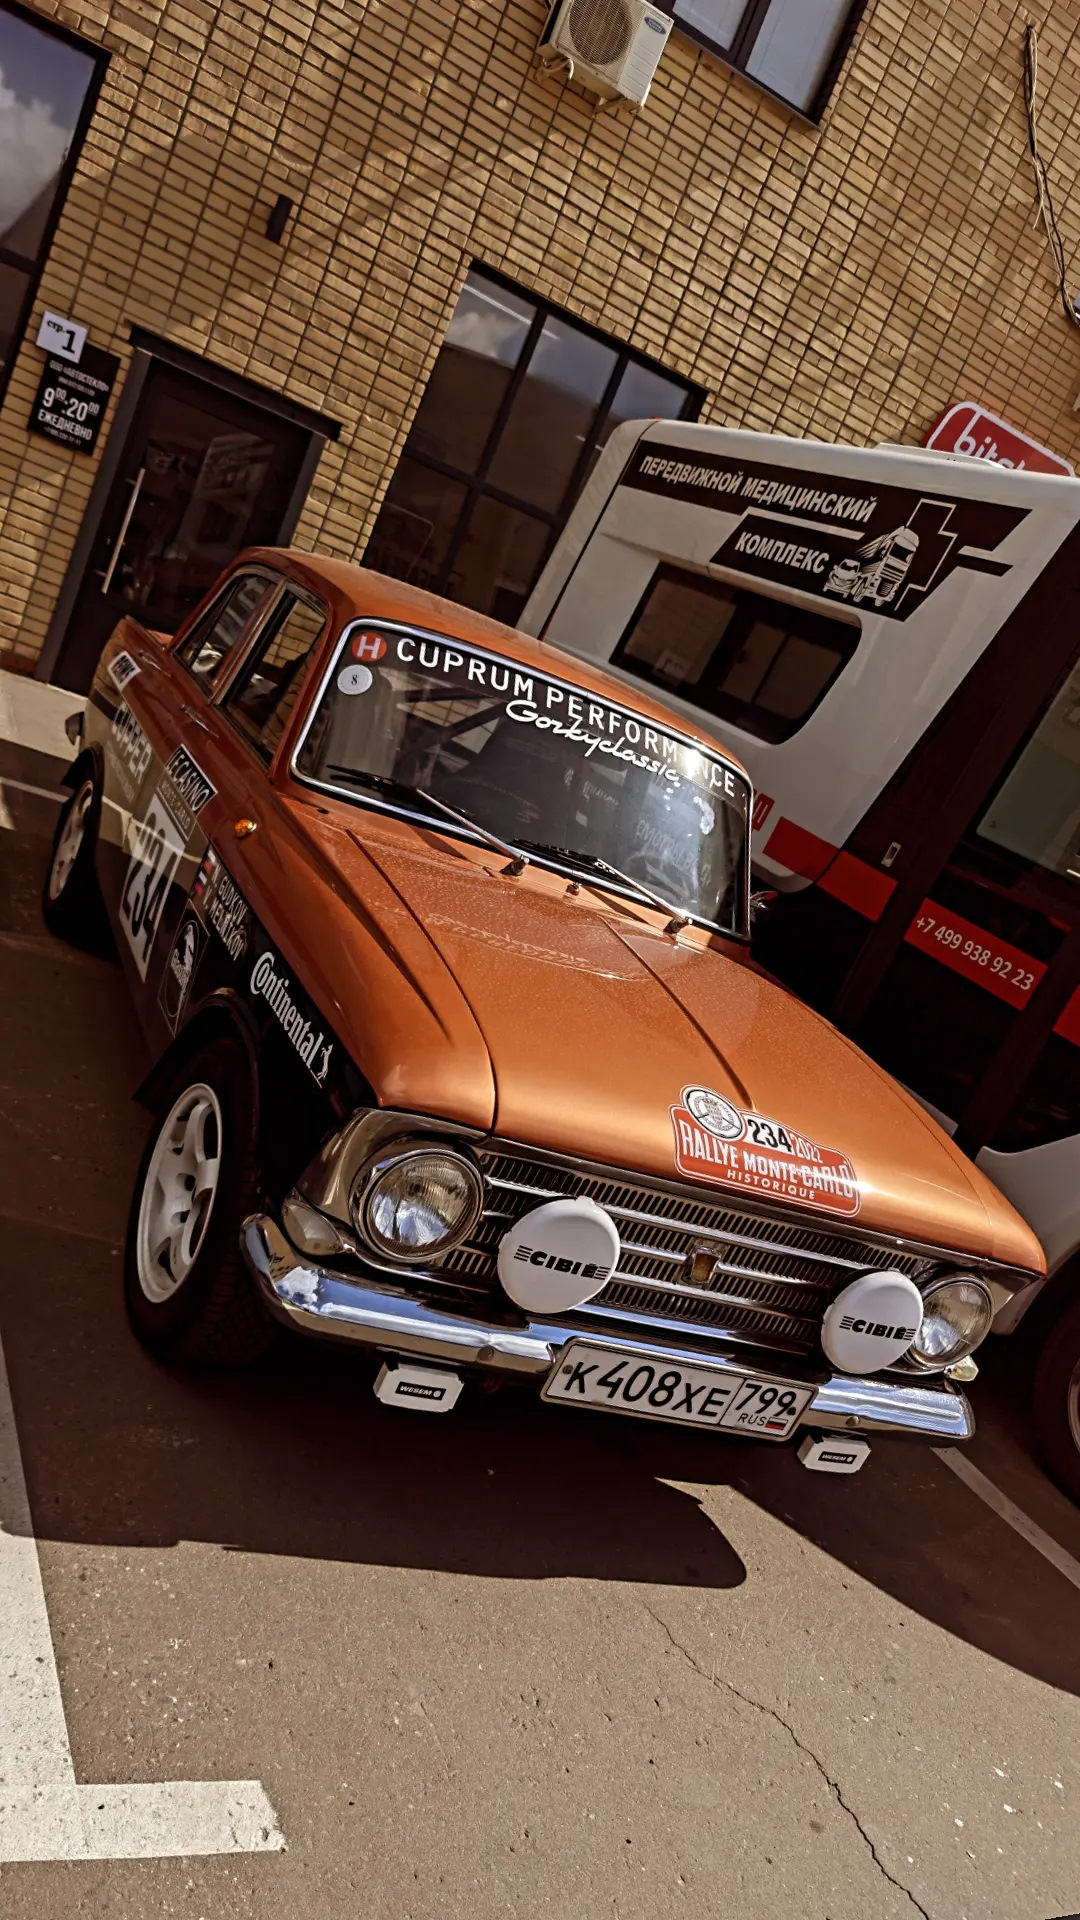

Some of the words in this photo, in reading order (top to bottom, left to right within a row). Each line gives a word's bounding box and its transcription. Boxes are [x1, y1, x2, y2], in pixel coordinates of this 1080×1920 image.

[61, 330, 76, 354] 1
[38, 409, 93, 441] ЕЖЕДНЕВНО
[639, 456, 743, 494] ПЕРЕДВИЖНОЙ
[740, 476, 877, 523] МЕДИЦИНСКИЙ
[734, 531, 830, 574] КОМПЛЕКС
[351, 674, 358, 686] 8
[396, 638, 534, 701] CUPRUM
[546, 685, 736, 797] PERFORMNCE
[218, 875, 248, 925] GUDKOV
[916, 917, 936, 933] +7
[934, 925, 963, 949] 499
[961, 940, 991, 966] 938
[990, 956, 1012, 979] 92
[1010, 968, 1035, 991] 23
[249, 951, 324, 1070] Continental
[678, 1118, 739, 1169] RALLYE
[747, 1119, 793, 1153] 234
[789, 1132, 824, 1164] 2022
[727, 1168, 816, 1200] HISTORIQUE
[400, 1385, 433, 1396] WESEM
[735, 1383, 798, 1418] 799
[737, 1412, 767, 1428] RUS
